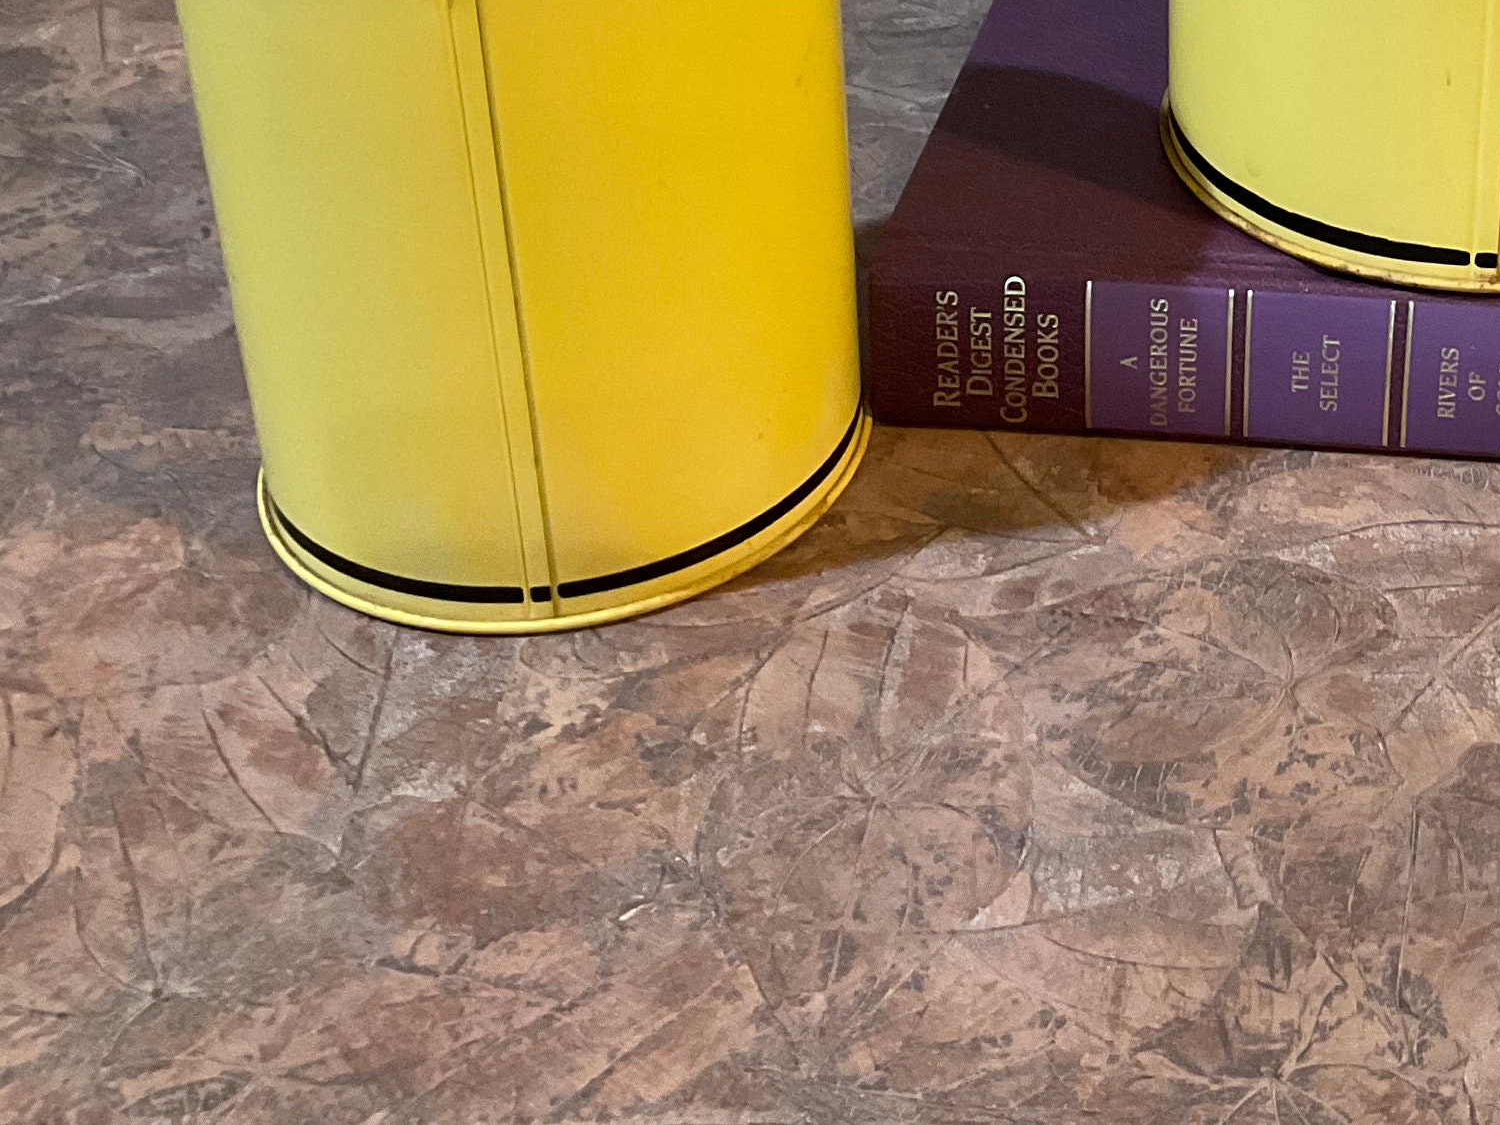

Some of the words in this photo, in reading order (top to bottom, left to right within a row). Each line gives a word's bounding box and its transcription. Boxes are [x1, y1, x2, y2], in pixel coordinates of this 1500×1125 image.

[933, 290, 961, 407] READER'S
[966, 306, 993, 396] DIGEST
[1000, 275, 1028, 424] CONDENSED
[1032, 314, 1059, 398] BOOKS
[1120, 356, 1138, 370] A
[1150, 298, 1169, 427] DANGEROUS
[1178, 317, 1198, 414] FORTUNE
[1292, 351, 1310, 393] THE
[1320, 335, 1340, 411] SELECT
[1437, 347, 1460, 418] RIVERS
[1468, 371, 1486, 401] OF
